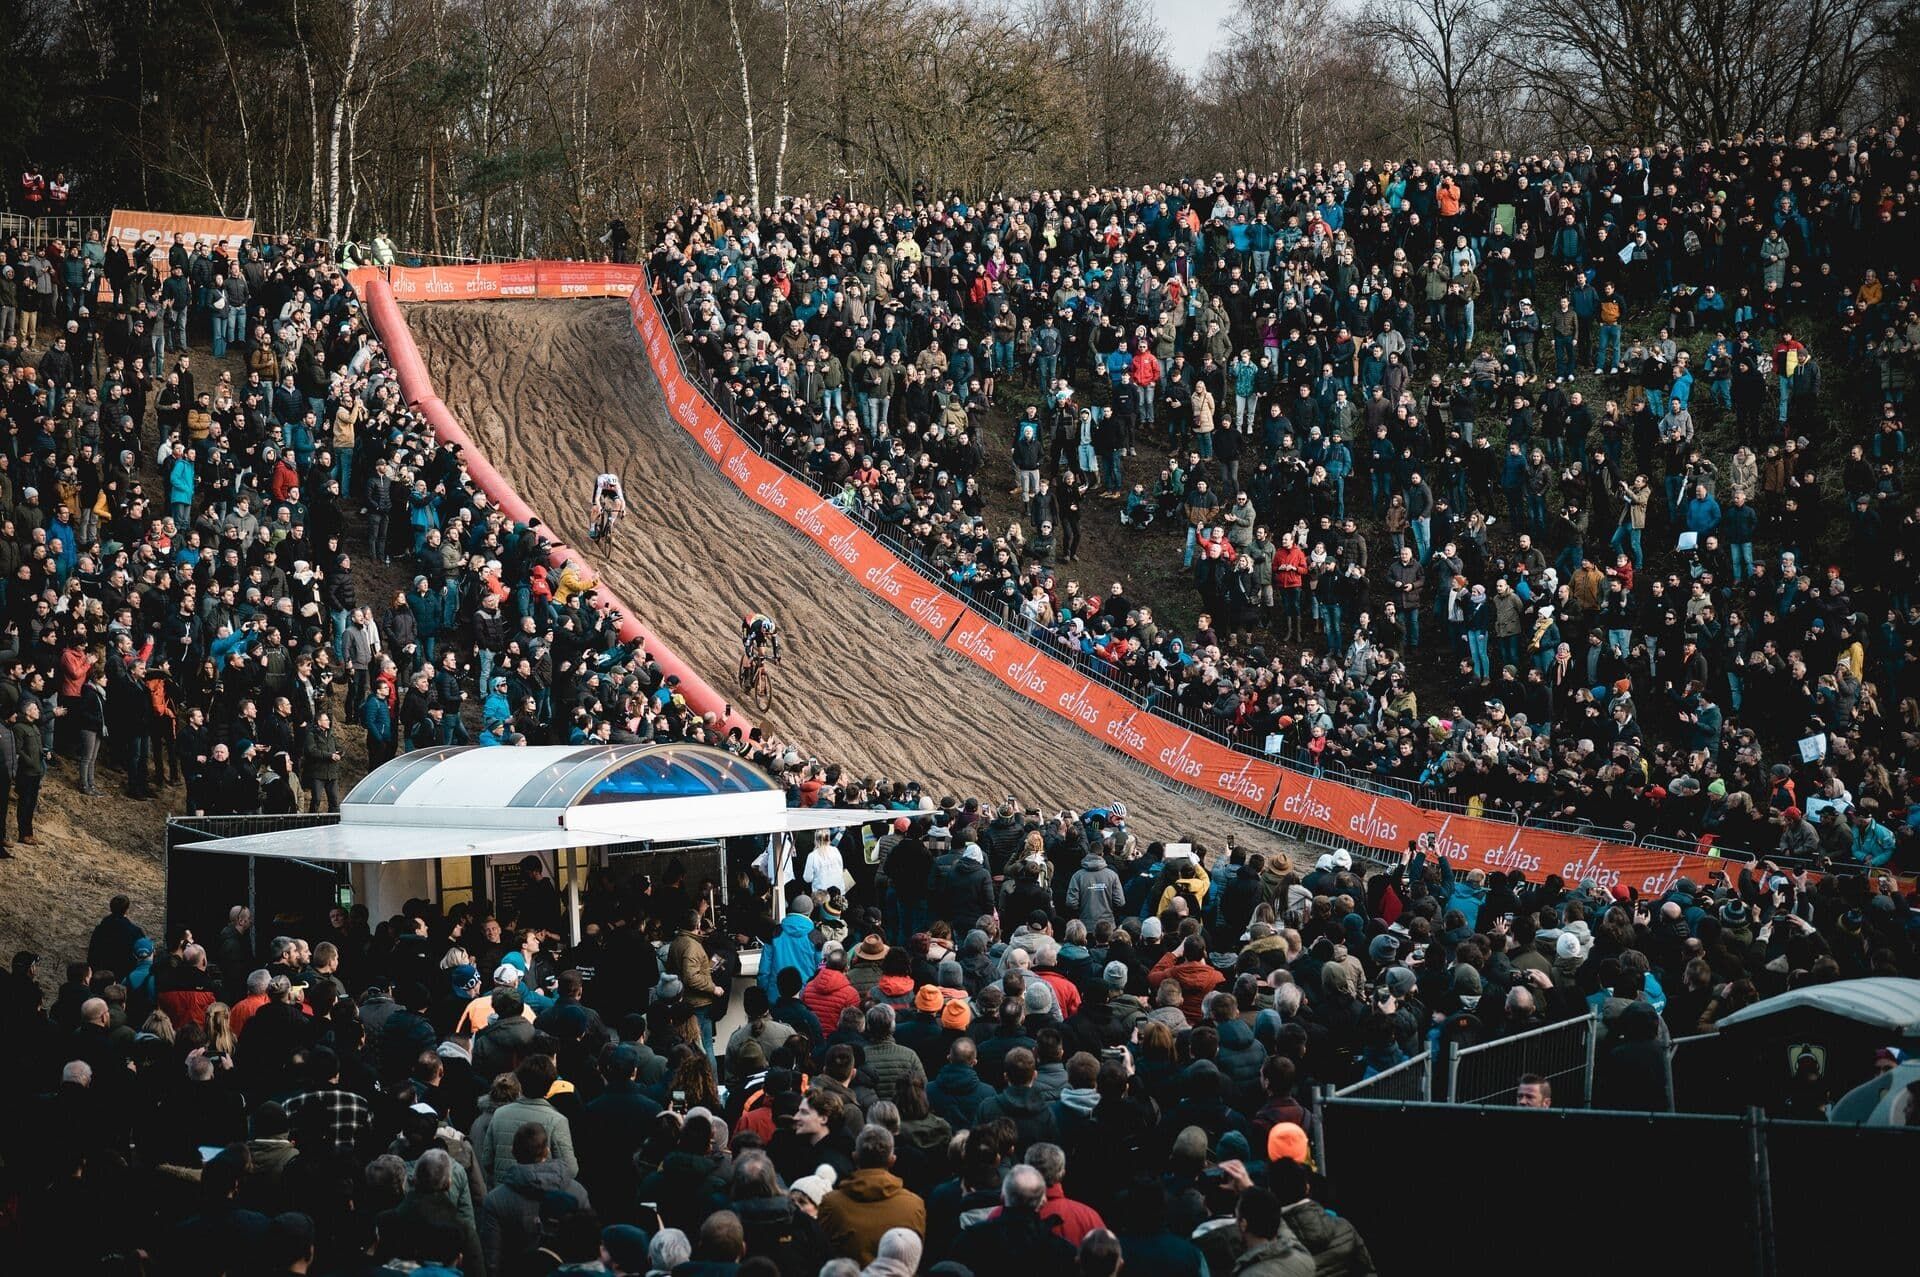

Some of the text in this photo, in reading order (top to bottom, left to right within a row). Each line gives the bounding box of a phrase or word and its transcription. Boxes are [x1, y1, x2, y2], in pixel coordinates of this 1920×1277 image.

[425, 268, 454, 293] ethias
[466, 267, 497, 292] ethias
[604, 283, 635, 292] STOC
[678, 393, 700, 426] ethias
[703, 421, 724, 455] ethias
[727, 448, 947, 630] ethias ethias ethias ethias ethias ethias
[957, 623, 1265, 803] ethias ethias ethias ethias ethias ethias
[1283, 779, 1331, 822] ethias
[1350, 798, 1398, 844] ethias
[1417, 815, 1469, 861] ehias
[1484, 827, 1541, 876] ethias
[1562, 841, 1621, 887] ethias
